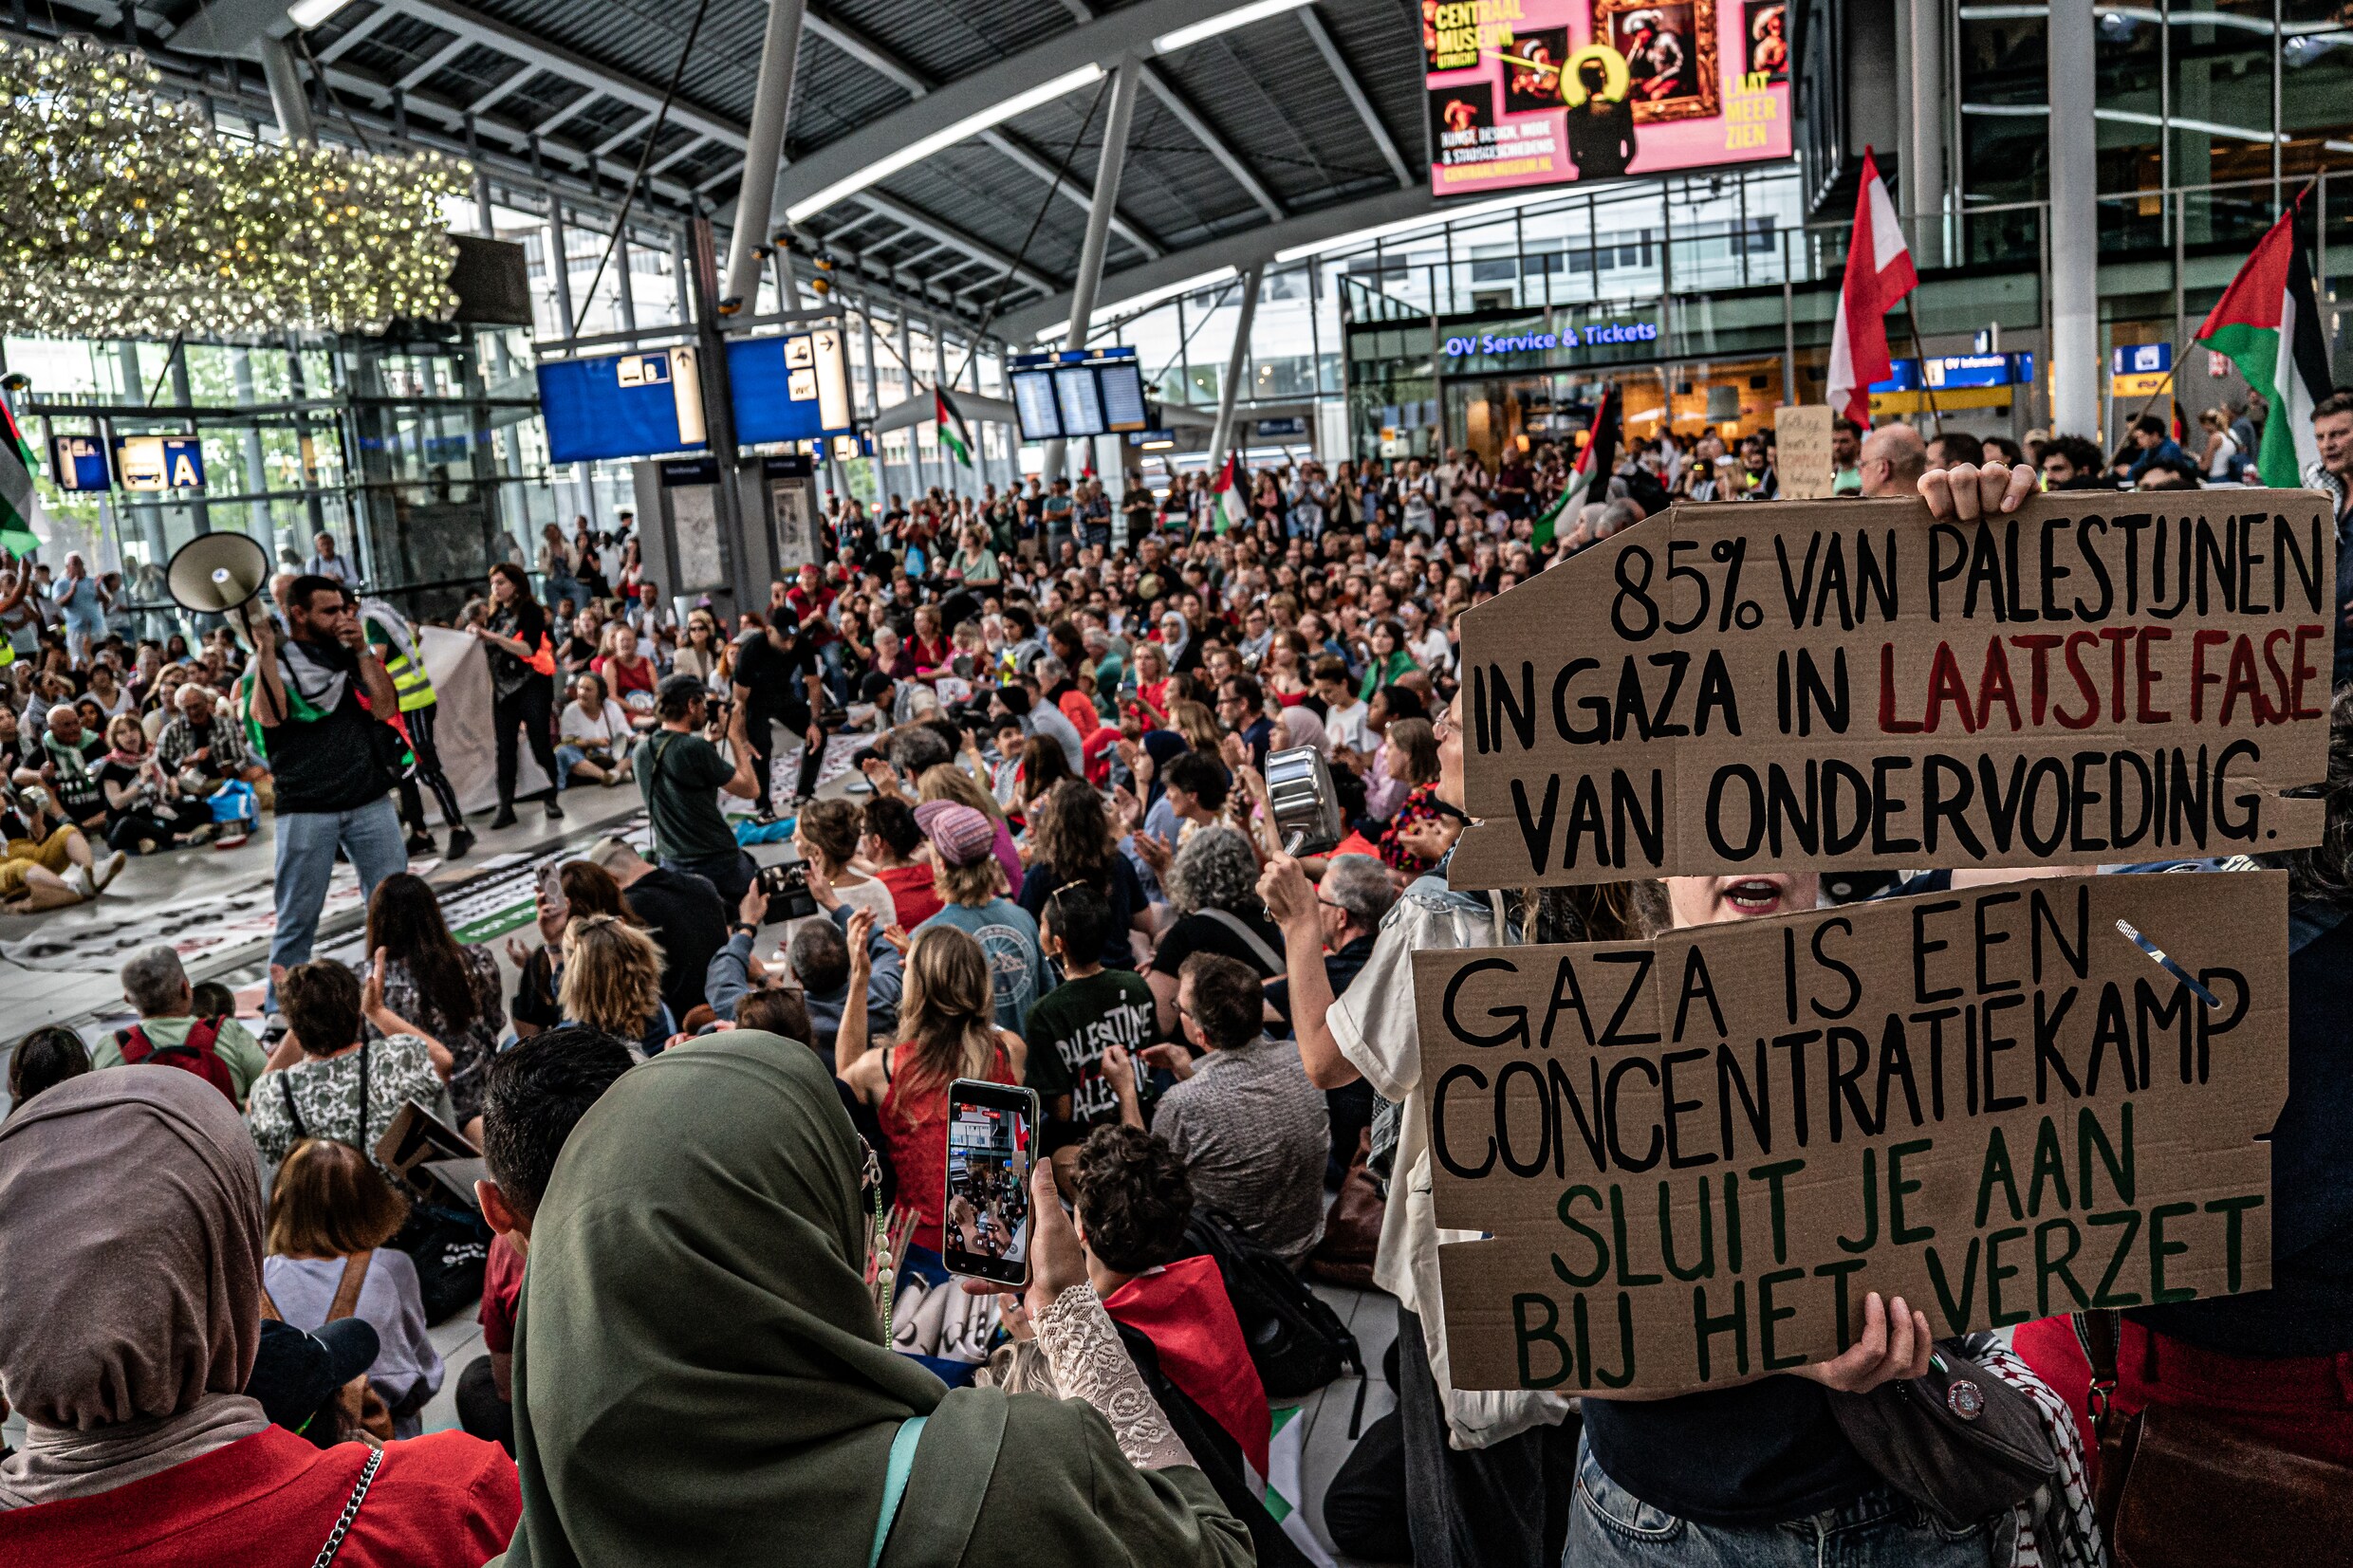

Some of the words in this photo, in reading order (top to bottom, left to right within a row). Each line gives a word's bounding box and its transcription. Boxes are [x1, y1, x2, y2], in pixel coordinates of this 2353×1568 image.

[1436, 0, 1526, 29] CENTRAAL
[1436, 22, 1514, 53] MUSEUM
[1724, 70, 1771, 100] LAAT
[1726, 97, 1776, 122] MEER
[1725, 122, 1767, 151] ZIEN
[1445, 336, 1477, 357] OV
[1482, 330, 1556, 355] Service
[1562, 327, 1579, 348] &
[1584, 322, 1657, 345] Tickets
[174, 454, 198, 486] A
[1610, 536, 1764, 642] 85%
[1774, 527, 1898, 631] VAN
[1927, 513, 2324, 623] PALESTIJNEN
[1473, 661, 1536, 754] IN
[1552, 649, 1742, 744] GAZA
[1776, 646, 1850, 737] IN
[1878, 625, 2173, 735] LAATSTE
[2191, 624, 2325, 728] FASE
[1510, 767, 1664, 876] VAN
[1706, 738, 2277, 862] ONDERVOEDING.
[1442, 946, 1729, 1049] GAZA
[1784, 916, 1862, 1025] IS
[1912, 884, 2089, 1005] EEN
[1055, 989, 1154, 1074] PALESTINE
[1433, 967, 2251, 1179] CONCENTRATIEKAMP
[1551, 1159, 1806, 1287] SLUIT
[1837, 1138, 1936, 1253] JE
[1974, 1101, 2137, 1229] AAN
[1517, 1291, 1636, 1390] BIJ
[1694, 1258, 1867, 1382] HET
[1925, 1193, 2266, 1337] VERZET
